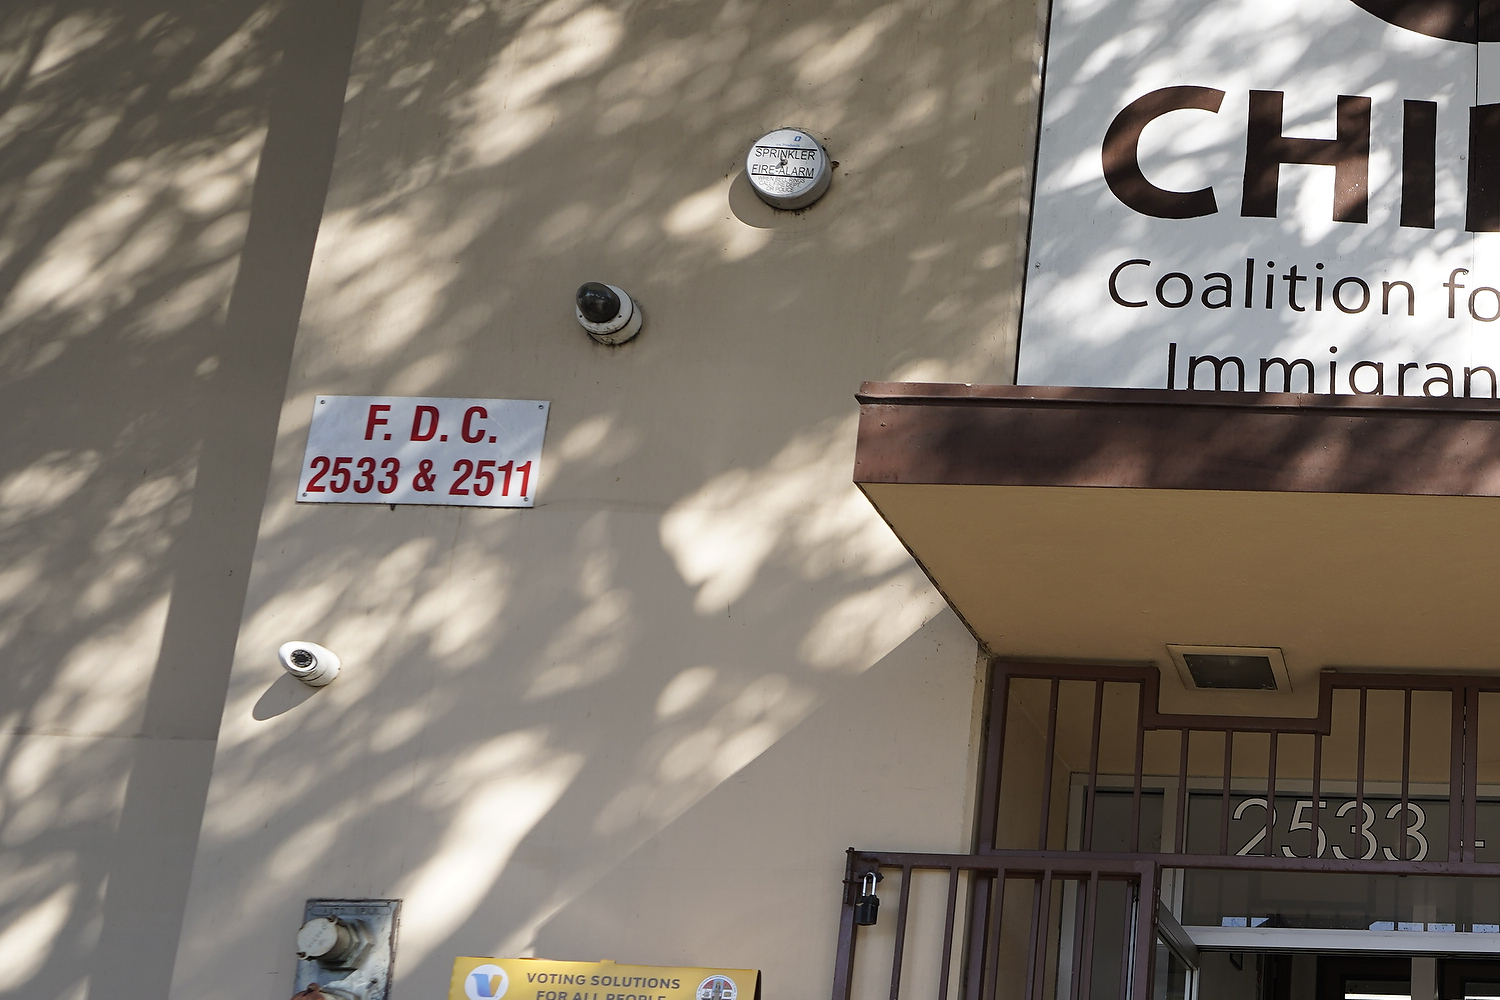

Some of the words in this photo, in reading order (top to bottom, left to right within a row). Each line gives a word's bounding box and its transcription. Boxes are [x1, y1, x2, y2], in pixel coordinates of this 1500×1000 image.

[755, 148, 816, 161] SPRINKLER
[1107, 258, 1416, 318] Coalition
[364, 404, 392, 441] F.
[410, 405, 448, 442] D.
[461, 406, 497, 444] C.
[306, 455, 401, 494] 2533
[412, 458, 436, 492] &
[448, 458, 532, 497] 2511
[1231, 797, 1430, 861] 2533
[526, 973, 587, 986] VOTING
[589, 976, 681, 992] SOLUTIONS
